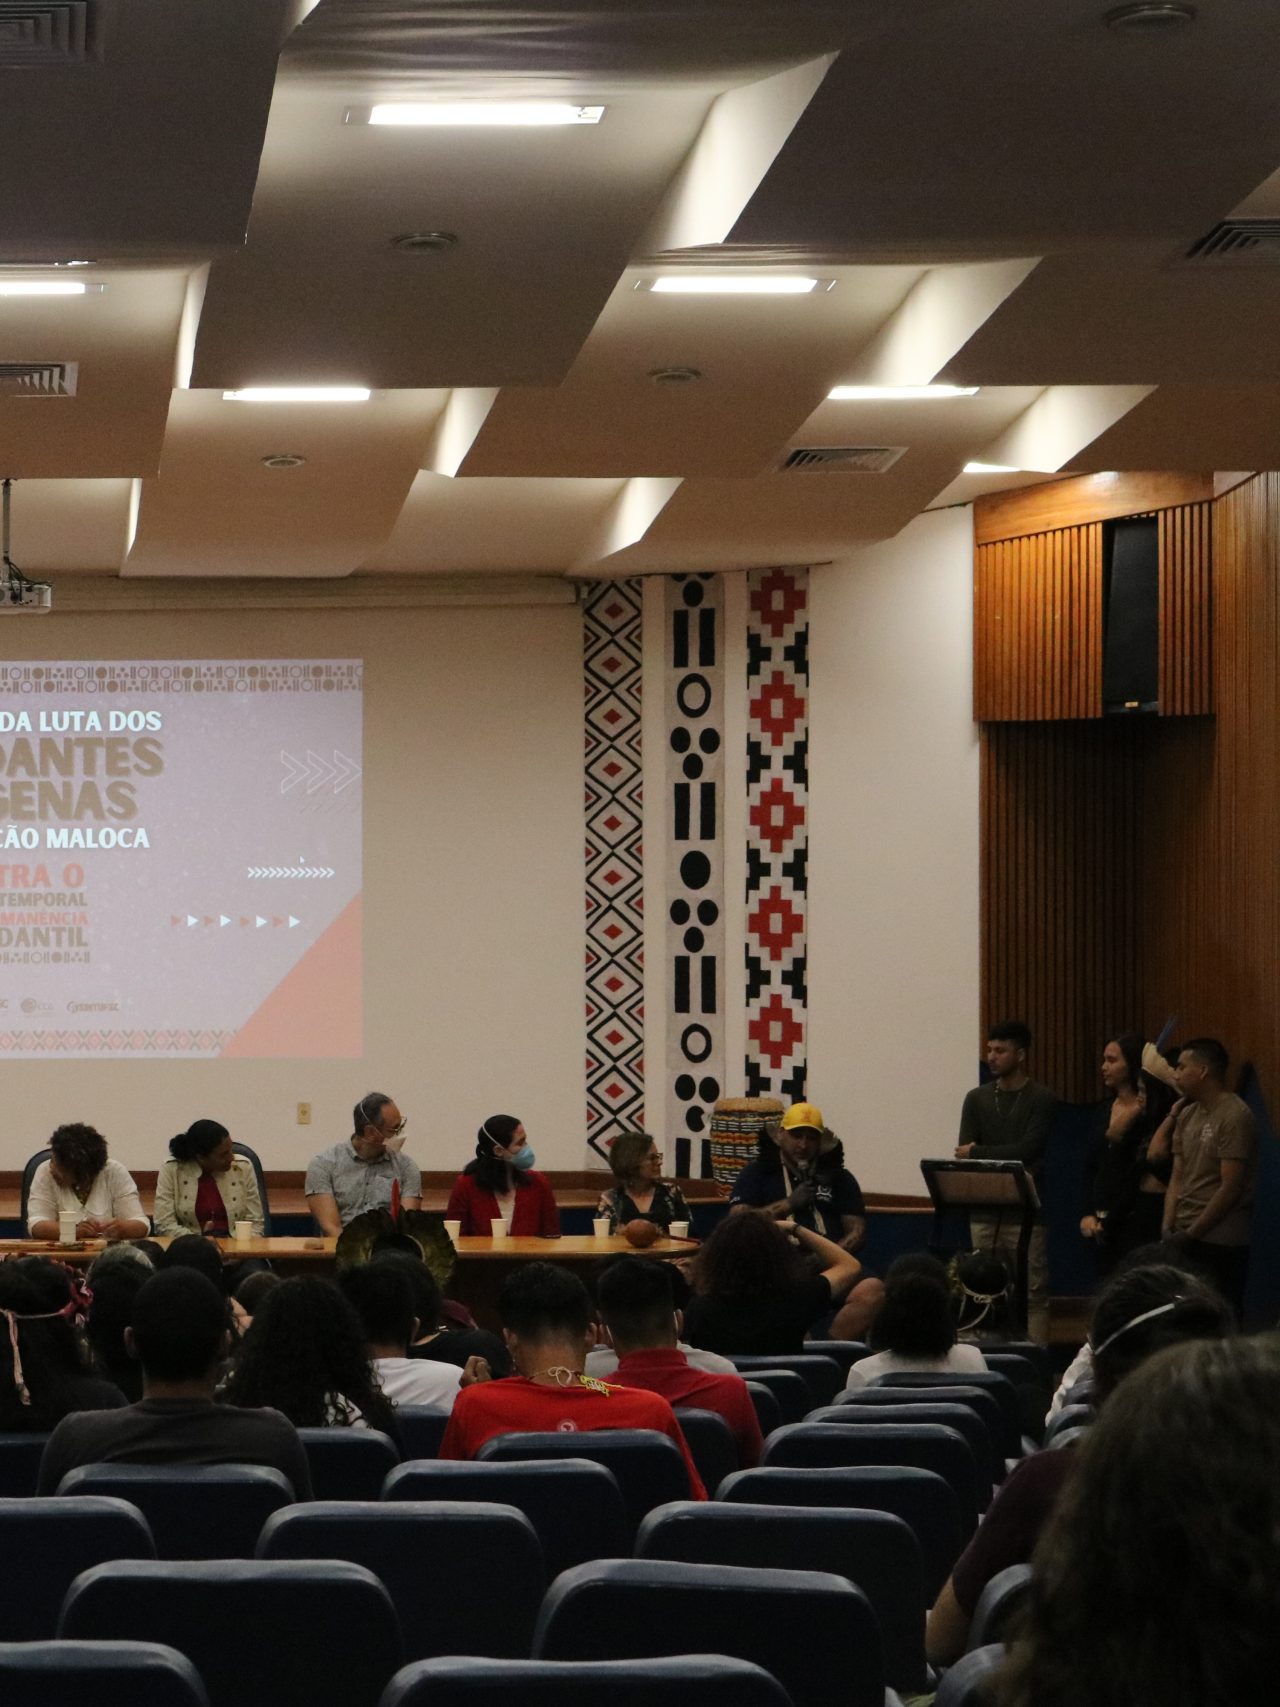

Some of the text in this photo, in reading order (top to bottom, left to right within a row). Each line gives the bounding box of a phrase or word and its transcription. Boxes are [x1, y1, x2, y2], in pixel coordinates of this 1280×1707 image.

[39, 710, 102, 732] LUTA
[109, 710, 162, 732] DOS
[46, 828, 150, 849] MALOCA
[63, 863, 85, 888] O
